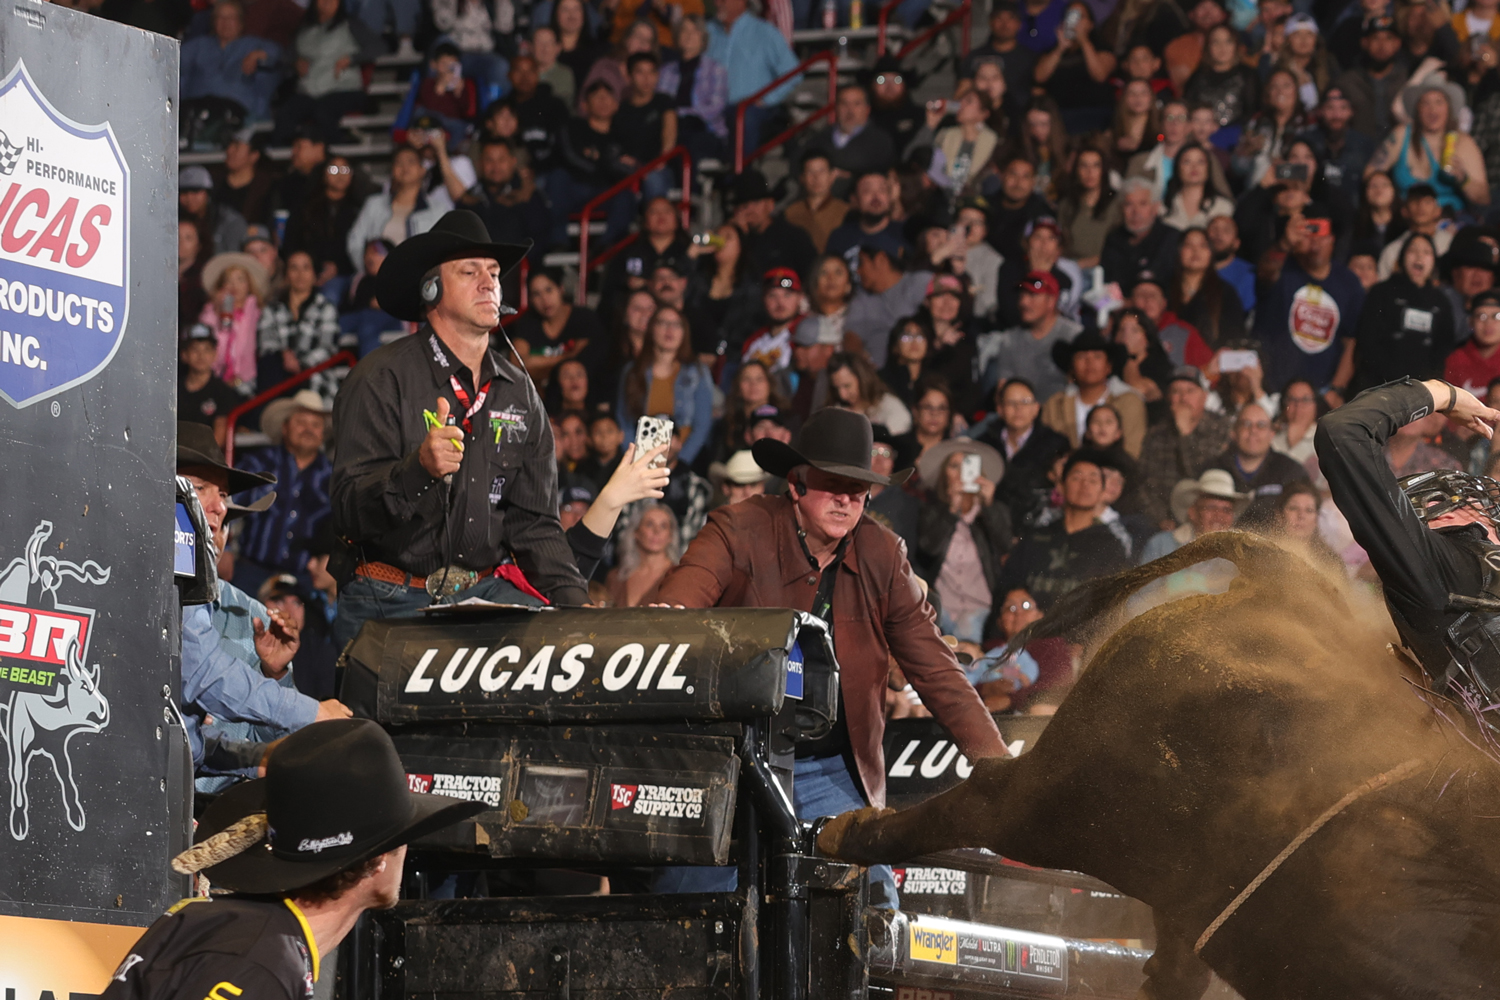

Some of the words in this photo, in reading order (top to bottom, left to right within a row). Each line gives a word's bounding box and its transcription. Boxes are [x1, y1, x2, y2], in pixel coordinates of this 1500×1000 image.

[26, 159, 117, 196] PERFORMANCE
[0, 178, 112, 268] CAS
[9, 666, 56, 687] BEAST
[404, 643, 594, 693] LUCAS
[602, 643, 690, 691] OIL
[433, 773, 502, 791] TRACTOR
[612, 784, 633, 807] TSC
[638, 784, 703, 803] TRACTOR
[633, 800, 686, 818] SUPPLY
[905, 867, 967, 881] TRACTOR
[903, 880, 950, 894] SUPPLY
[913, 928, 954, 959] Wrangler
[982, 939, 1002, 953] ULTRA
